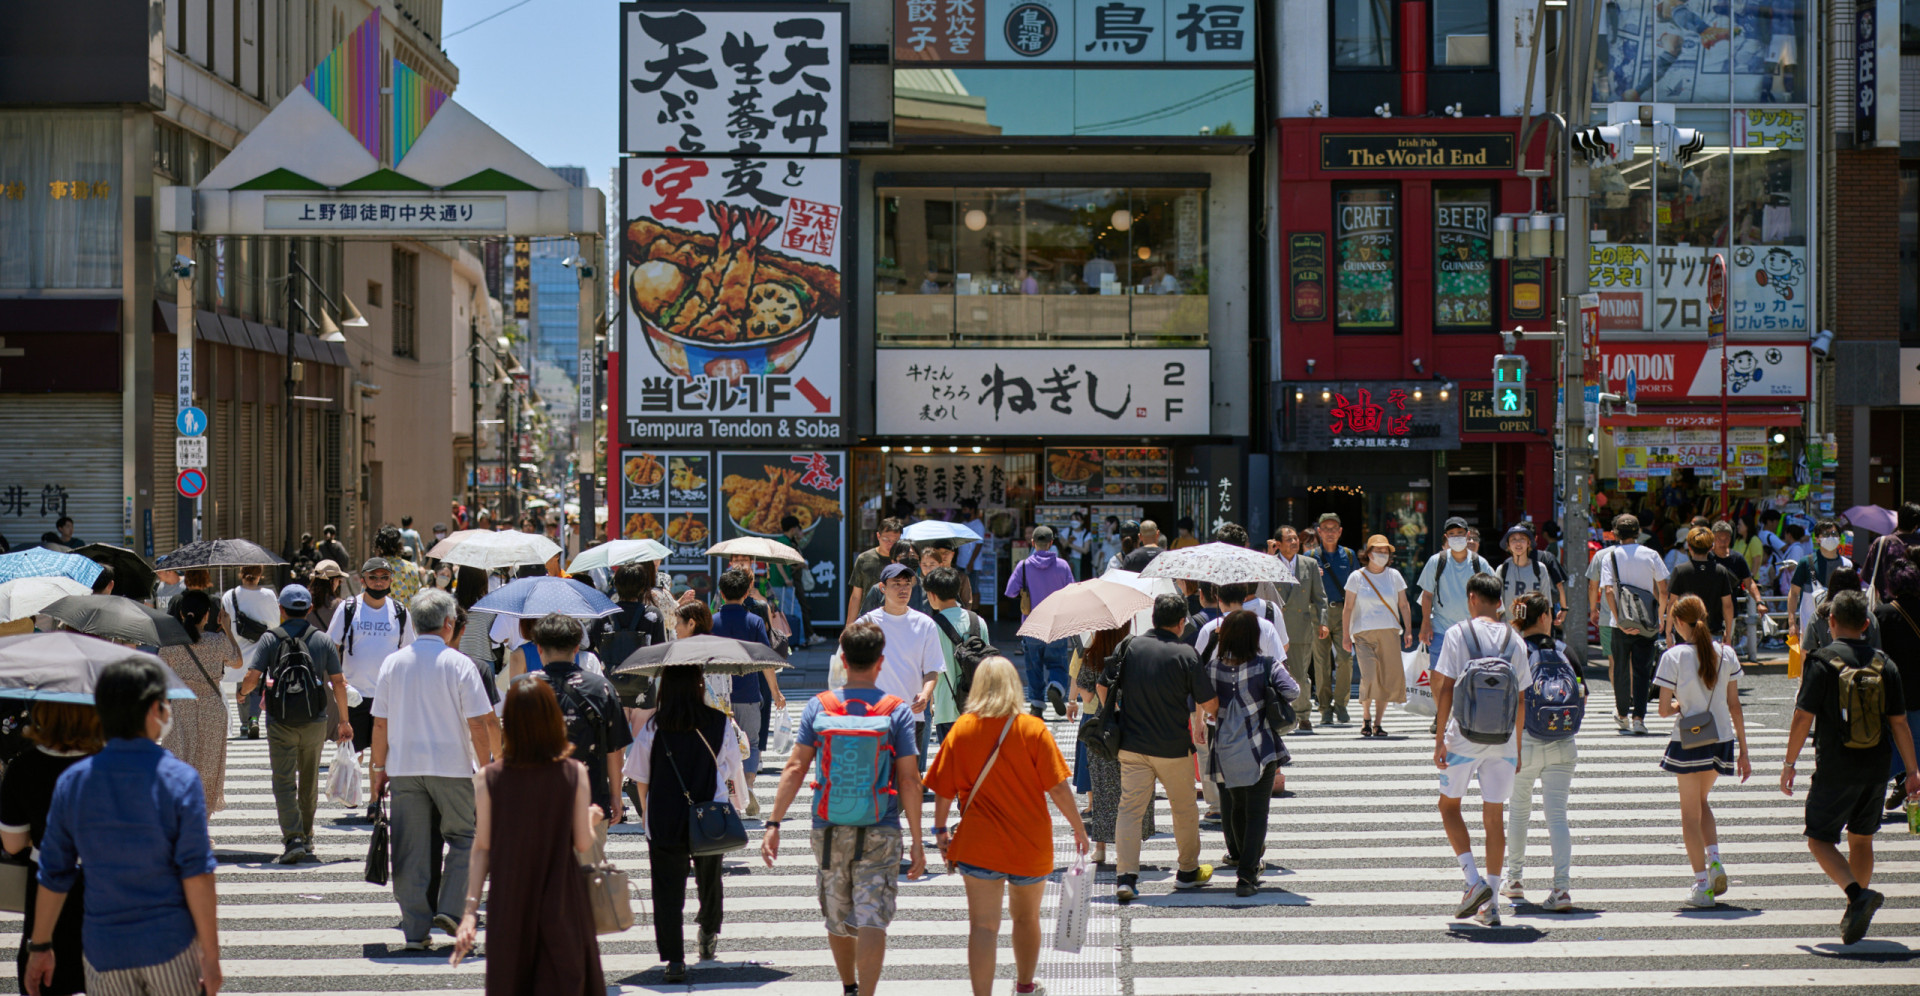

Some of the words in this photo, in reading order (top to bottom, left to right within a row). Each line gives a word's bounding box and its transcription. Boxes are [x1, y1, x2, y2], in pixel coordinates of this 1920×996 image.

[906, 0, 937, 52] 餃子
[945, 0, 976, 54] 水炊き
[1017, 9, 1046, 50] 鳥福
[1085, 3, 1245, 54] 鳥福
[721, 31, 788, 207] 生蕎麦
[1747, 109, 1803, 127] サッカー
[1398, 138, 1418, 147] Irish
[1420, 138, 1438, 147] Pub
[1747, 131, 1803, 147] コーナー
[1348, 148, 1385, 166] The
[1386, 148, 1444, 166] World
[1450, 147, 1487, 166] End
[298, 203, 473, 222] 上野御徒町中央通り
[1342, 206, 1393, 231] CRAFT
[1438, 207, 1487, 232] BEER
[1361, 234, 1392, 246] クラフト
[1441, 233, 1465, 244] ビール
[1343, 260, 1387, 271] GUINNESS
[1441, 260, 1485, 271] GUINNESS
[1600, 299, 1639, 317] ONDON
[1734, 299, 1805, 313] サッカー
[1734, 315, 1805, 329] けんちゃん
[906, 364, 954, 382] 牛たん
[1601, 354, 1675, 381] LONDON
[180, 351, 190, 408] 大江戸線近
[582, 352, 591, 418] 大江戸線近道
[1636, 384, 1674, 392] SPORTS
[932, 384, 971, 400] とろろ
[978, 363, 1131, 422] ねぎし
[1470, 391, 1485, 402] 2F
[919, 404, 959, 421] 麦めし
[627, 419, 704, 441] Tempura
[708, 419, 773, 437] Tendon
[777, 419, 791, 437] &
[795, 419, 840, 437] Soba
[1500, 421, 1530, 431] OPEN
[1678, 446, 1719, 456] SALE
[1218, 477, 1232, 512] 牛たん
[357, 621, 392, 631] KENZO
[843, 736, 859, 796] NORTH
[857, 763, 870, 796] THE
